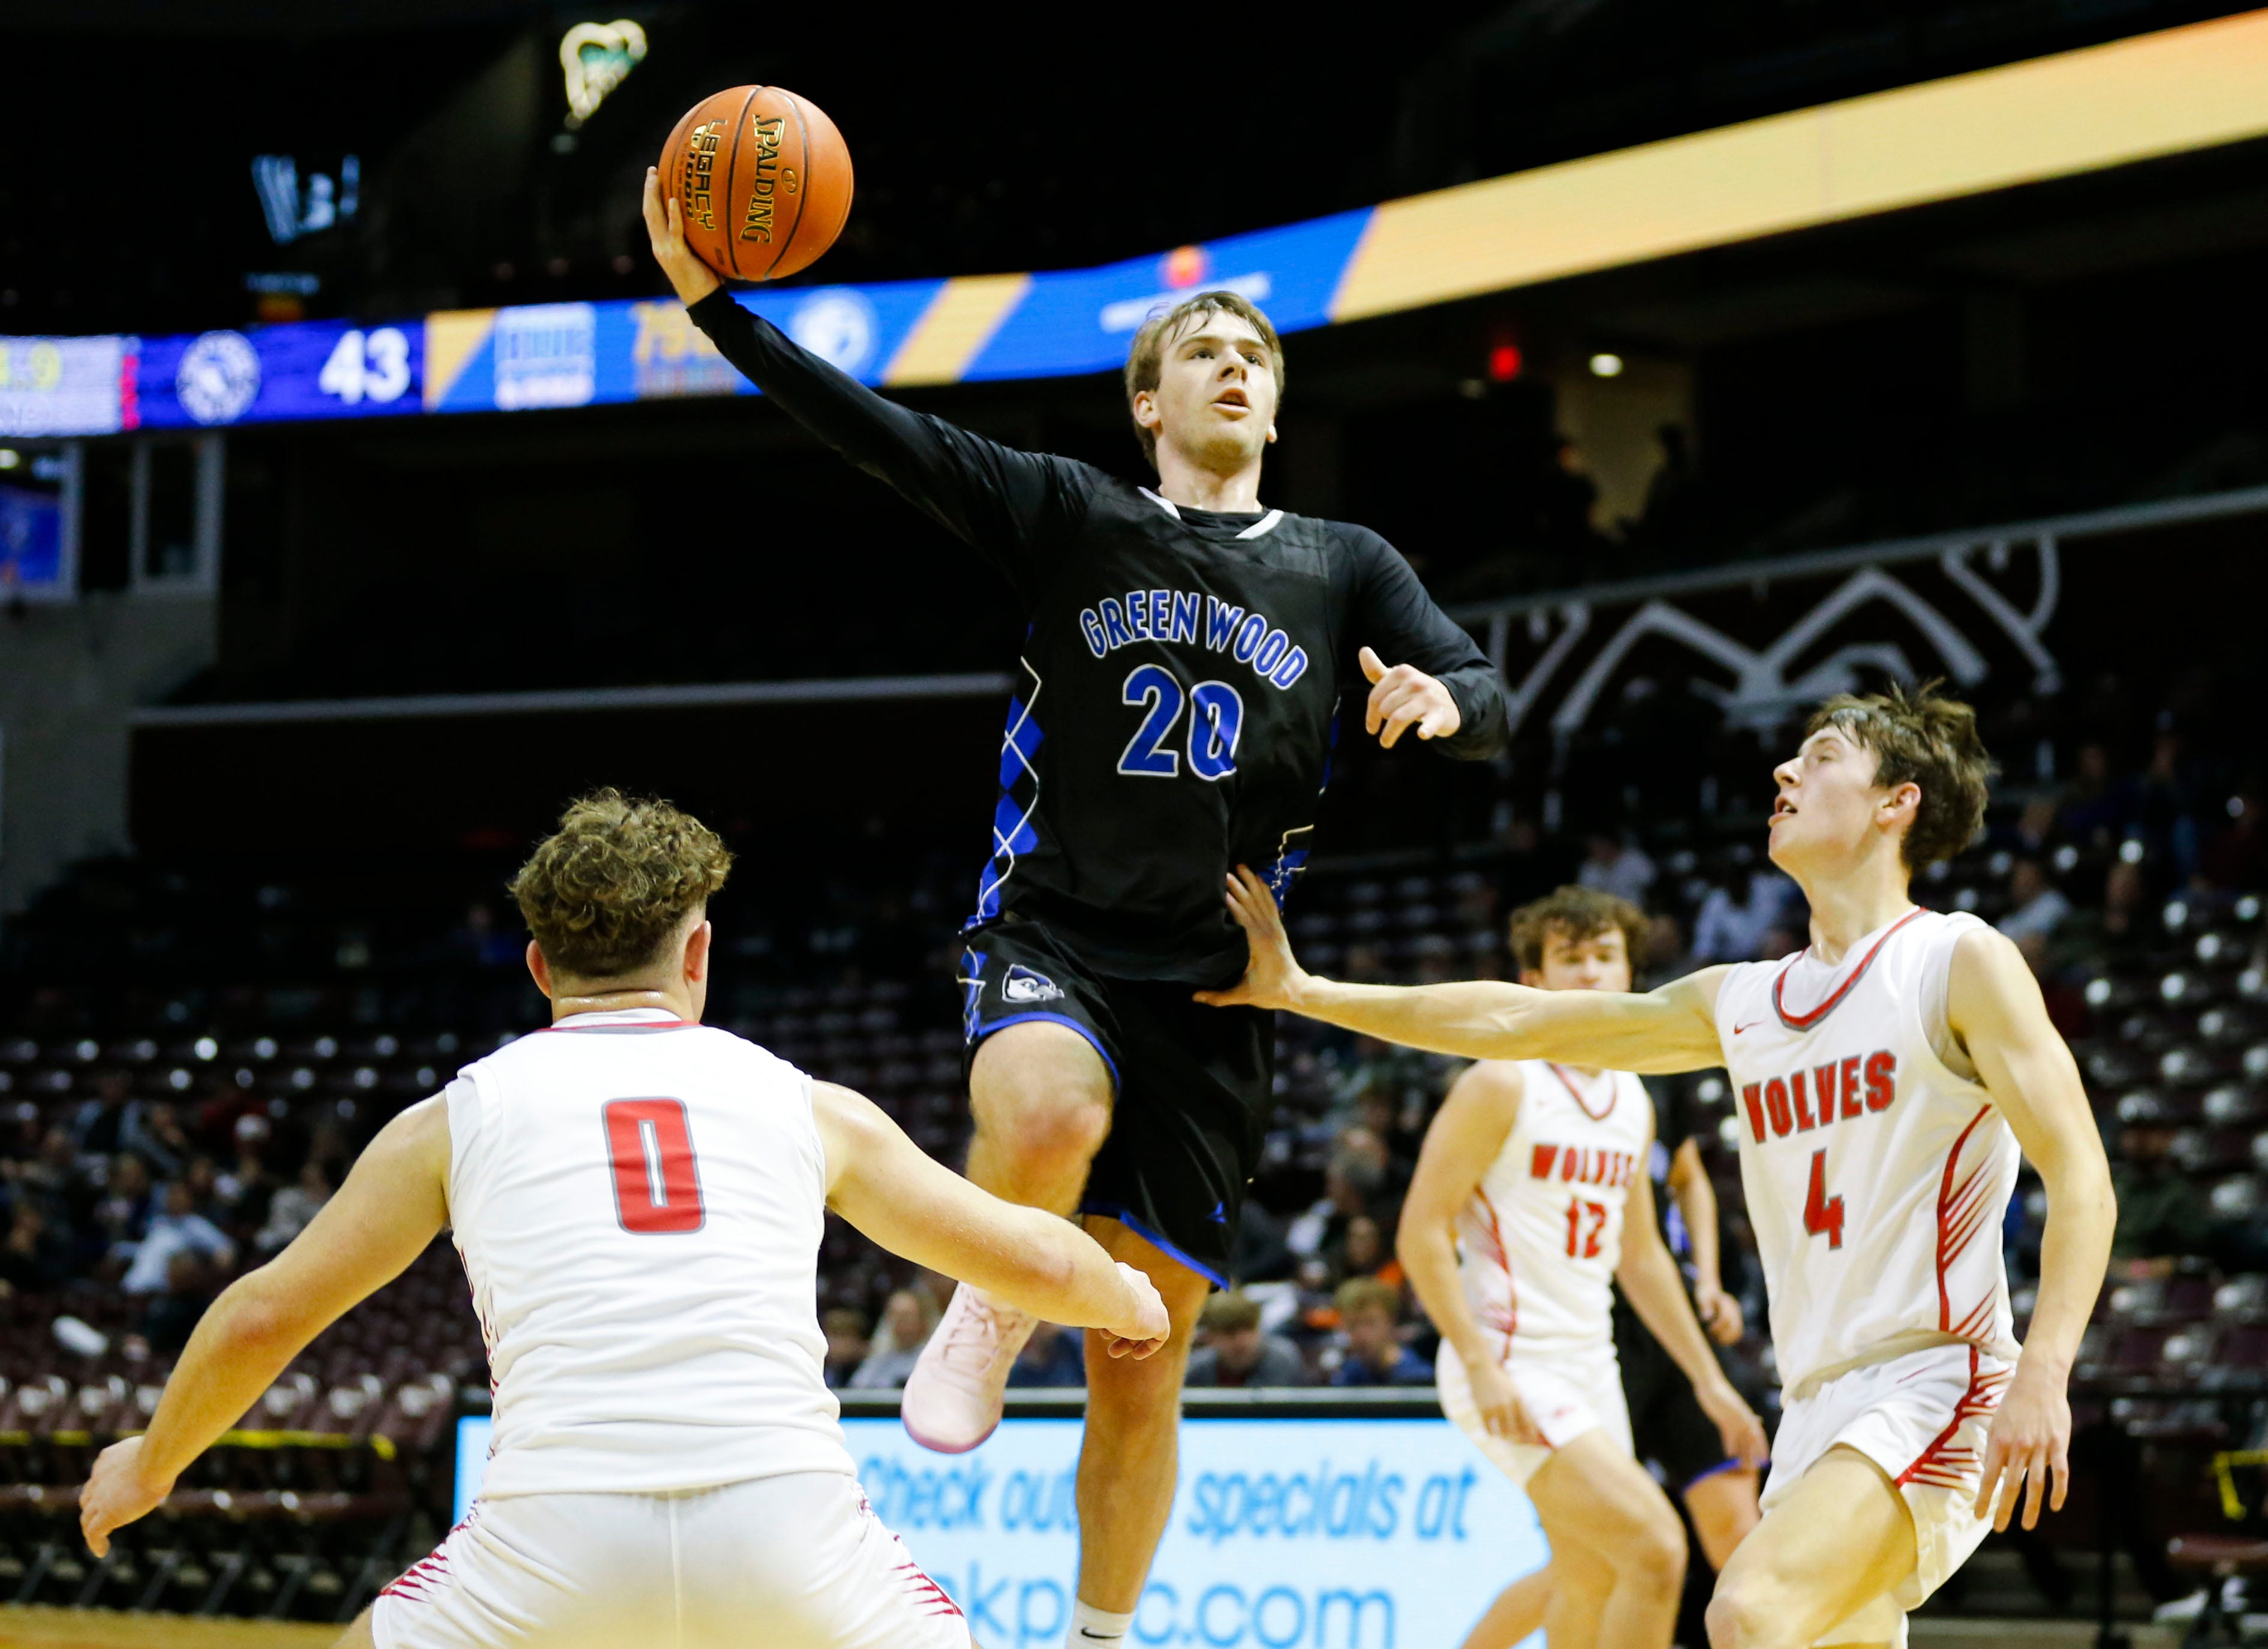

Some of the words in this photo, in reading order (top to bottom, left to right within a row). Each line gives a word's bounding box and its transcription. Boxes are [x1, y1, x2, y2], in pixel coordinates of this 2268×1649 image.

[694, 119, 727, 231] LEGACY
[739, 114, 786, 244] SPALDING
[318, 327, 411, 405] 43
[1117, 663, 1244, 781] 20
[601, 1096, 706, 1235] 0
[1530, 1143, 1634, 1188] WOLVES
[1804, 1147, 1845, 1251] 4
[1563, 1196, 1607, 1259] 12
[1187, 1456, 1406, 1548] specials
[1415, 1463, 1476, 1541] at
